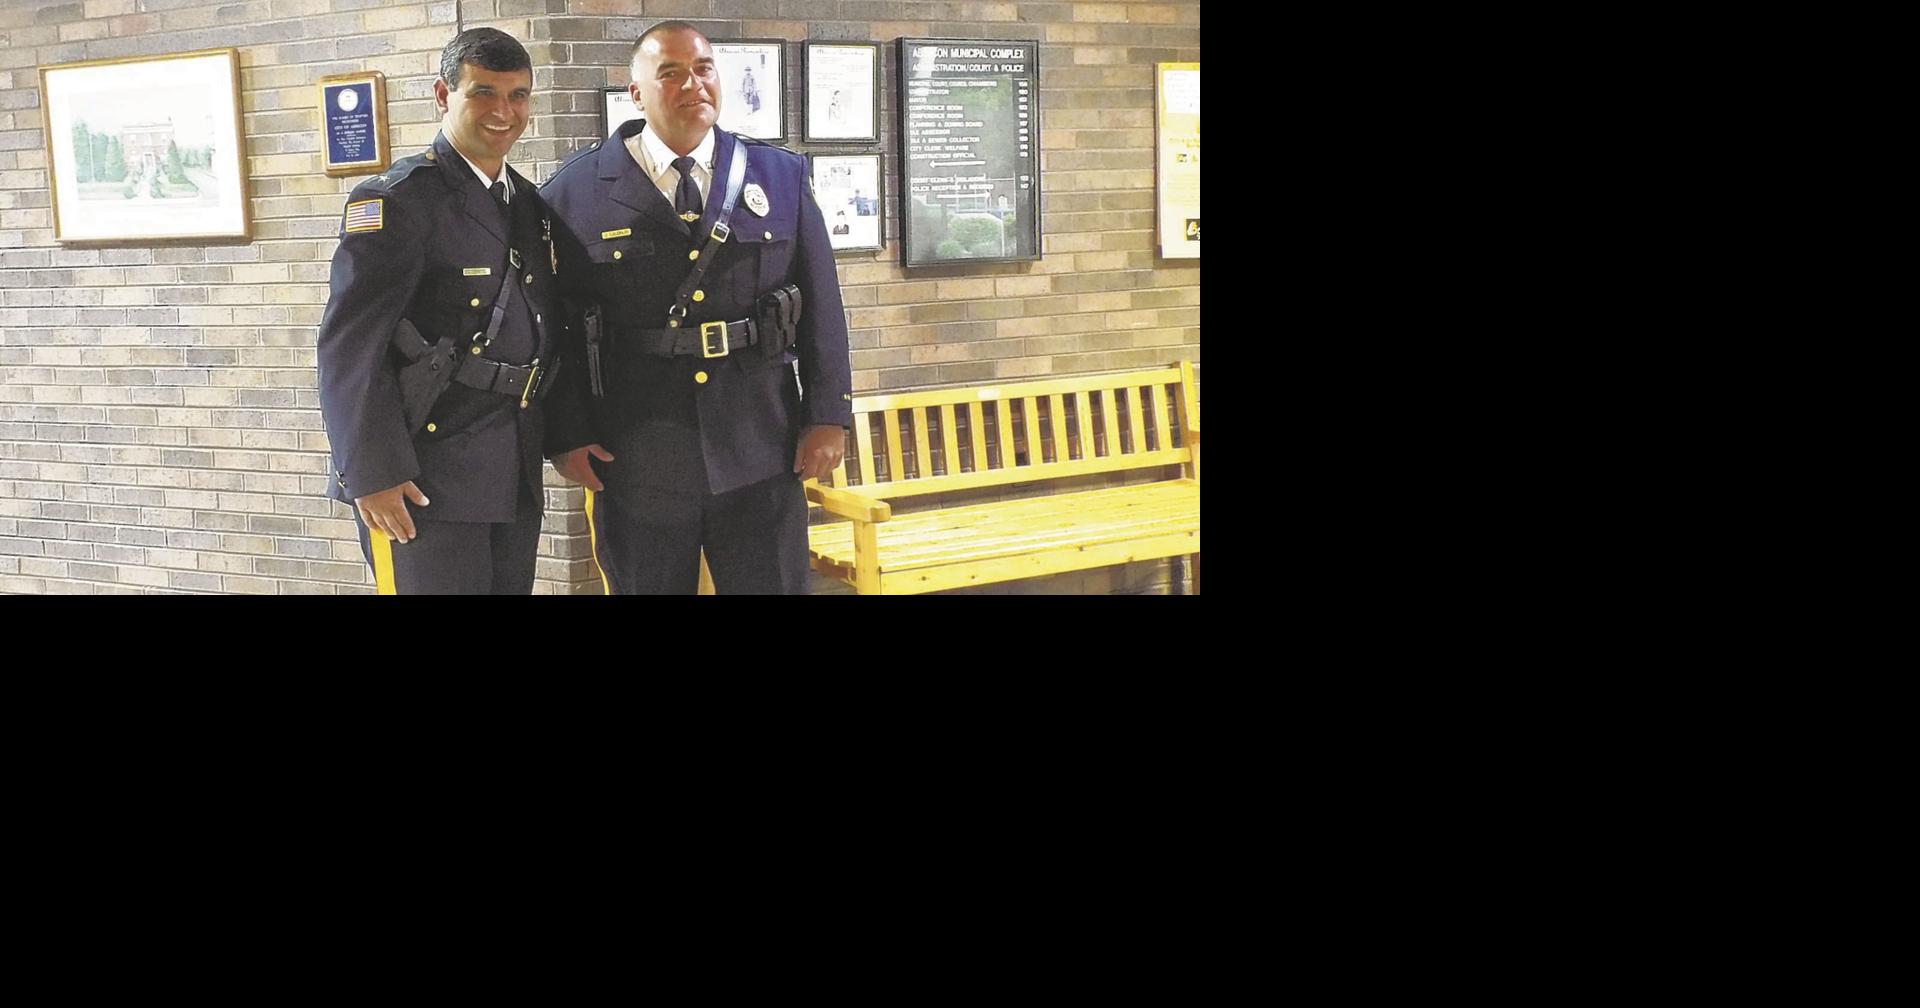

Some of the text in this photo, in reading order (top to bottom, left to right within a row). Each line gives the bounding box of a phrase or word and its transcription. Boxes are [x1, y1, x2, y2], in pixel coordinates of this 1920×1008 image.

[950, 48, 988, 58] MUNICIPAL
[990, 48, 1024, 58] COMPLEX
[1001, 64, 1024, 72] POLICE
